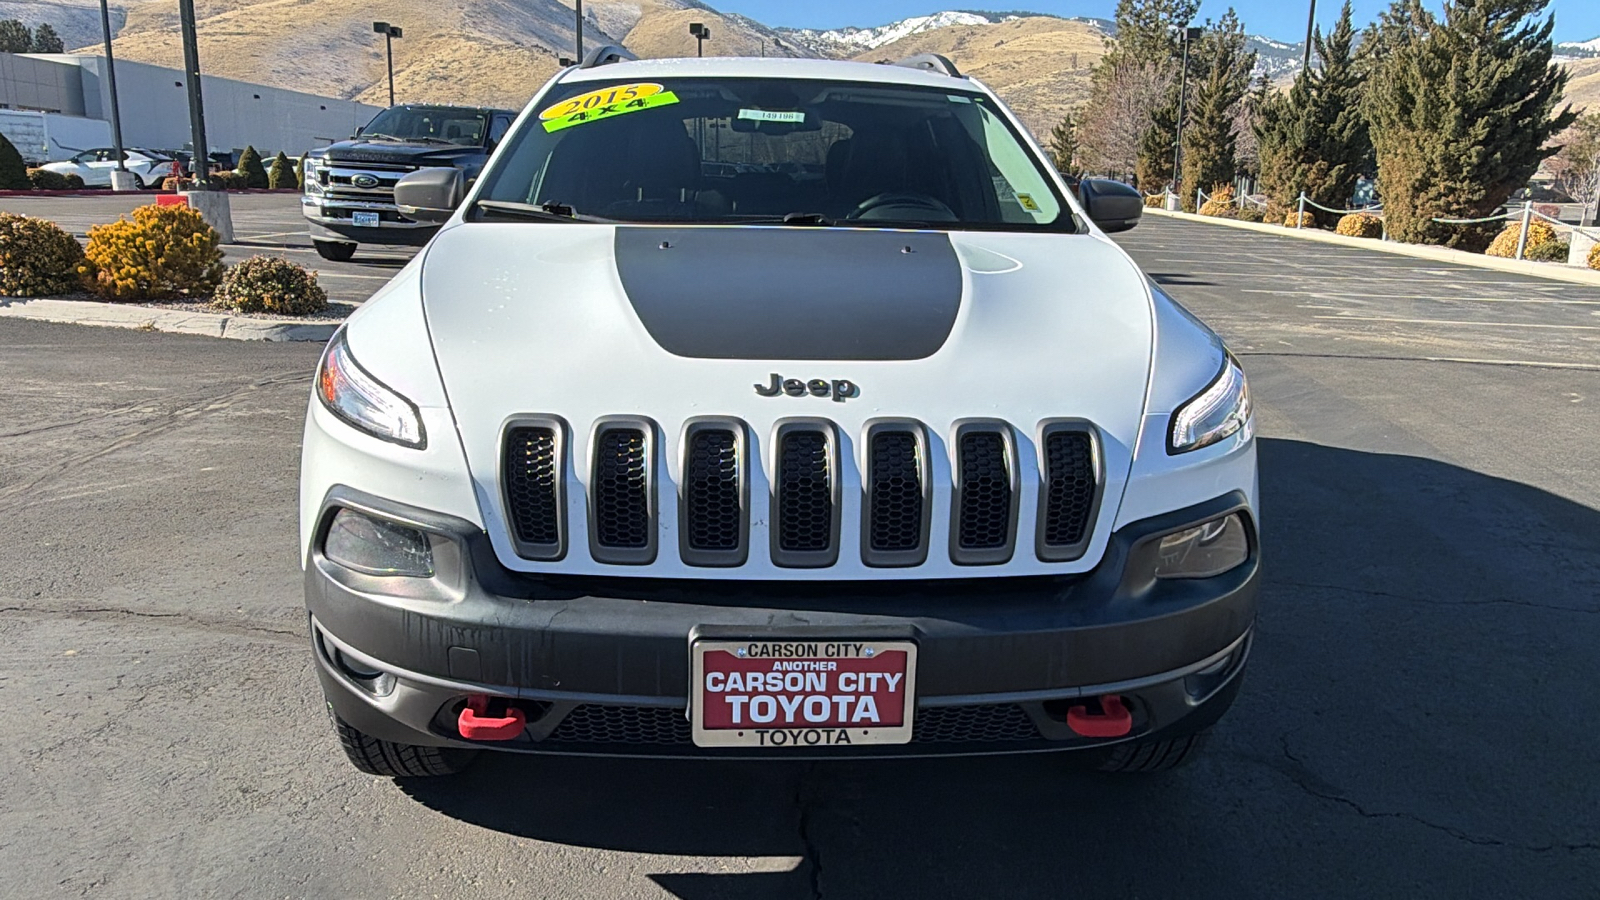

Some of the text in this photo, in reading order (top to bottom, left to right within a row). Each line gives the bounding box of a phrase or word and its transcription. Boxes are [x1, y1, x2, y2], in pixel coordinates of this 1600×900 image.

[562, 86, 639, 115] 2015
[753, 373, 858, 402] Jeep
[748, 643, 864, 658] CARSON CITY
[772, 661, 837, 671] ANOTHER
[706, 672, 903, 692] CARSON CITY
[725, 695, 880, 724] TOYOTA
[755, 729, 852, 746] TOYOTA
